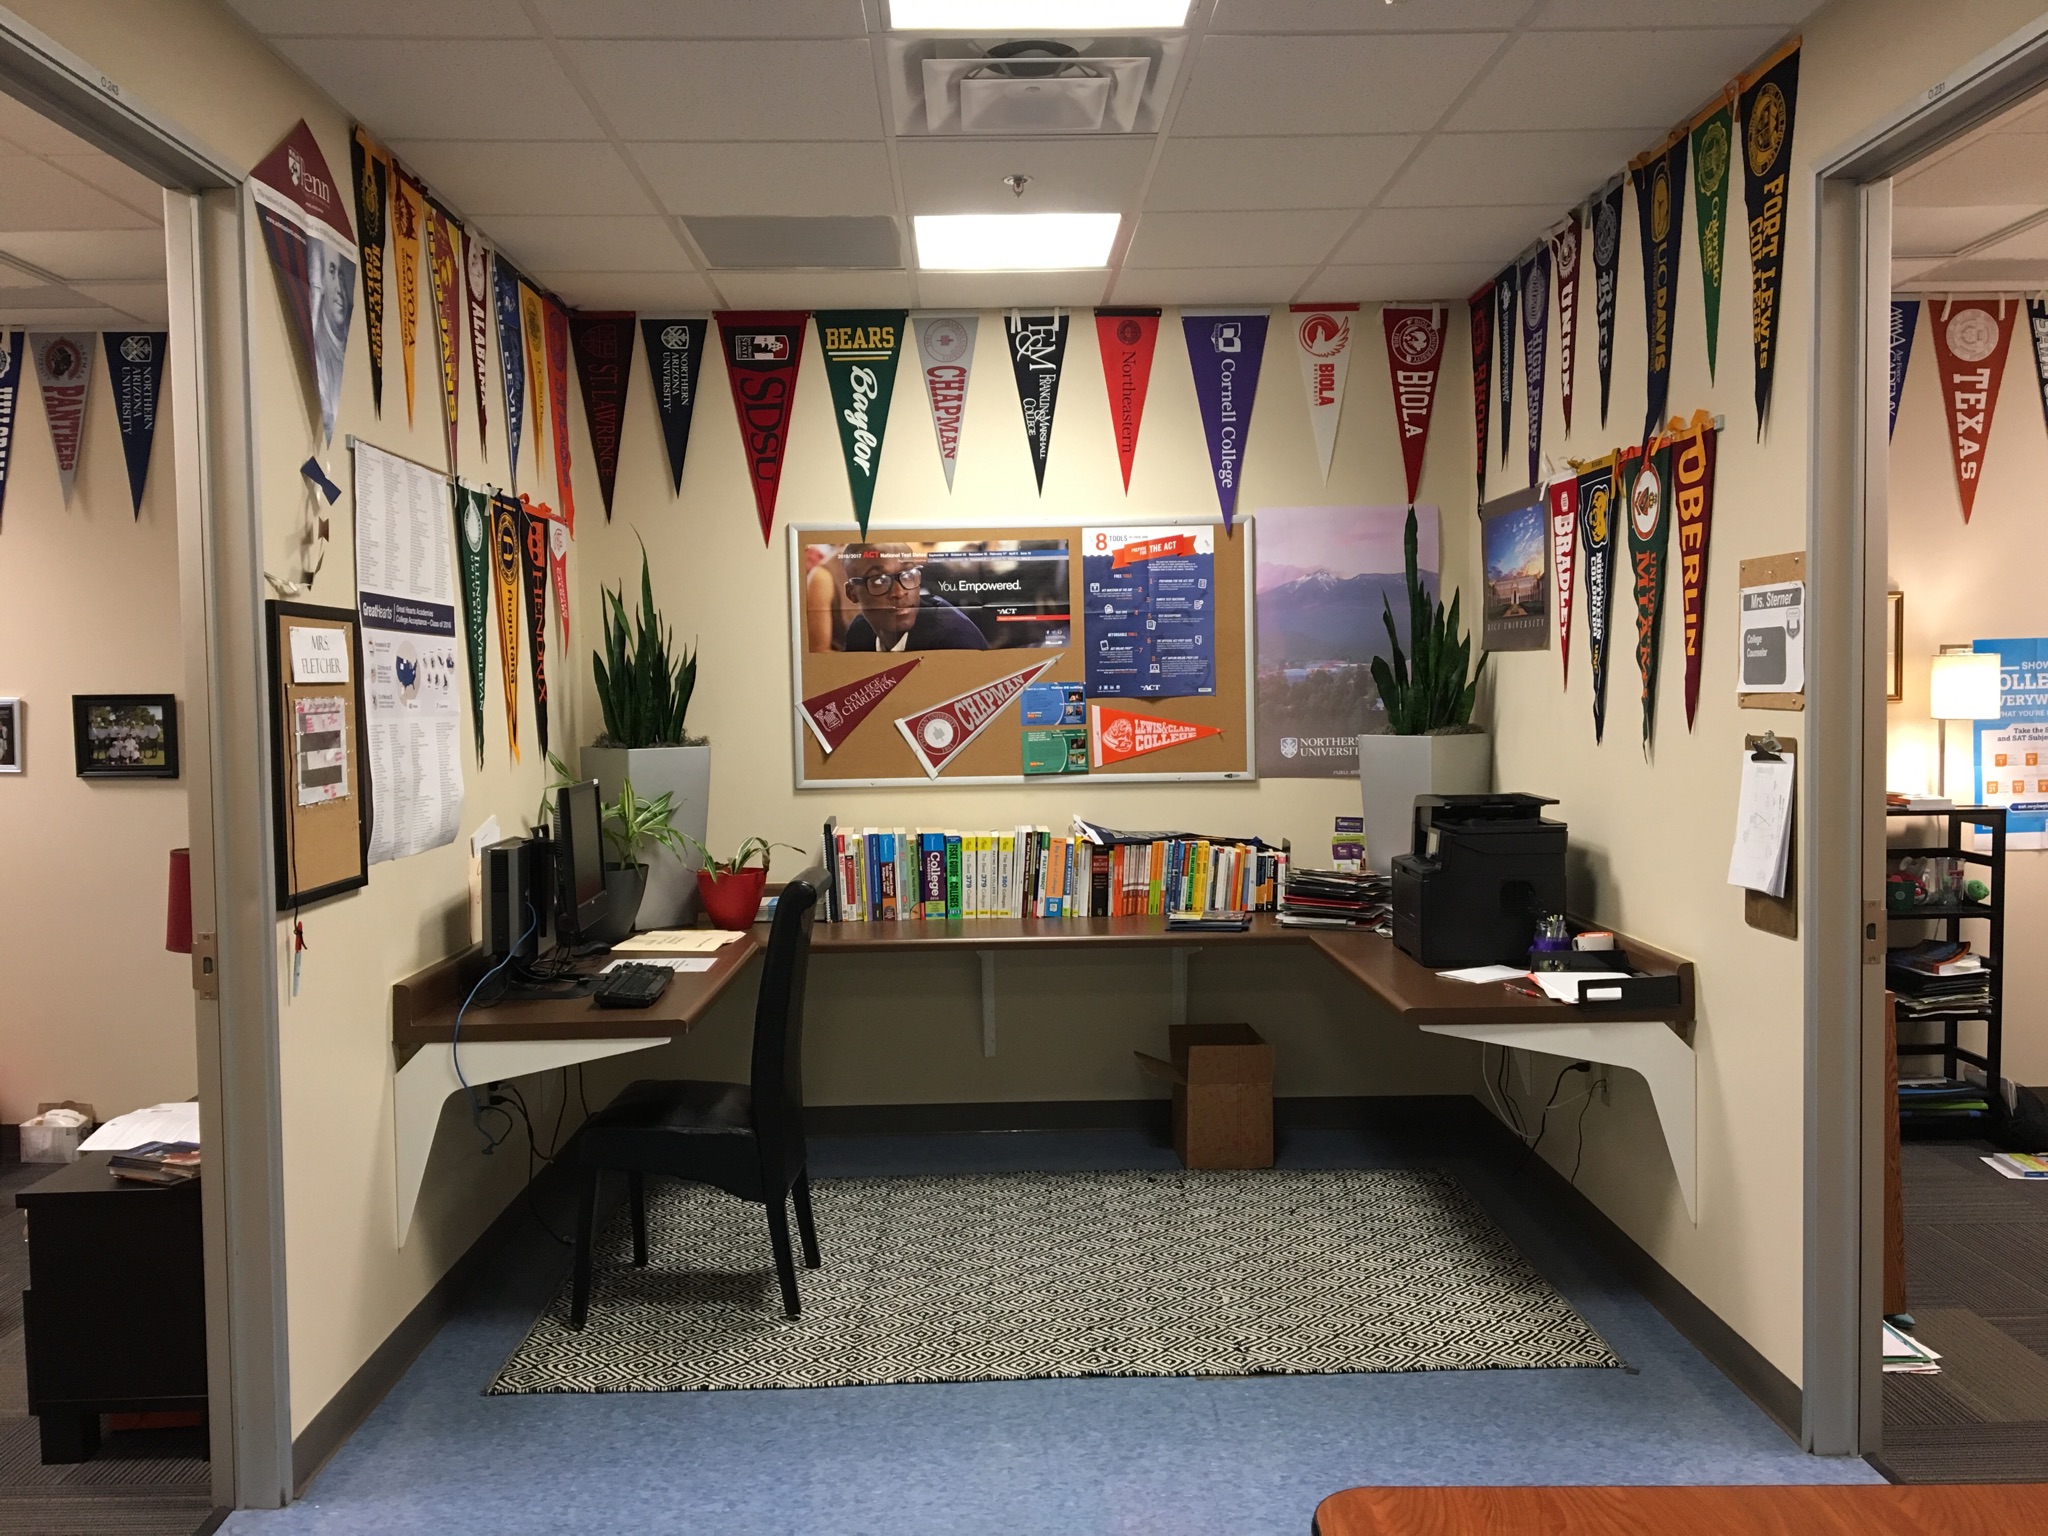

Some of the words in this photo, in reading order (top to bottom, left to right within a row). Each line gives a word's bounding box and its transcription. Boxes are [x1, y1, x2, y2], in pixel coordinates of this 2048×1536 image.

[1711, 196, 1721, 288] Colorado
[1763, 173, 1784, 258] FORT
[1704, 221, 1713, 270] State
[365, 246, 377, 358] COLLEGE
[372, 243, 382, 316] HARVEY
[405, 252, 415, 348] LOYOLA
[1749, 215, 1764, 344] COLLEGE
[374, 320, 382, 368] MUDD
[825, 327, 895, 350] BEARS
[1561, 281, 1574, 397] UNION
[1760, 267, 1776, 370] LEWIS
[472, 301, 487, 408] ALABAMA
[662, 352, 672, 411] UNIVERSITY
[671, 352, 680, 396] ARIZONA
[681, 352, 690, 406] NORTHERN
[1532, 329, 1543, 381] HIGH
[122, 366, 132, 435] UNIVERSITY
[133, 366, 142, 418] ARIZONA
[143, 367, 153, 430] NORTHERN
[504, 351, 518, 447] DEVILS
[926, 365, 968, 460] CHAPMAN
[1121, 351, 1136, 453] Northeastern
[1221, 359, 1236, 423] Cornell
[1319, 364, 1335, 407] BIOLA
[1397, 371, 1434, 438] BIOLA
[43, 385, 85, 472] PANTHERS
[591, 390, 617, 478] LAWRENCE
[739, 377, 787, 482] SDSU
[844, 365, 878, 477] Baylor
[1023, 398, 1037, 436] COLLEGE
[1530, 385, 1540, 451] POINT
[1953, 368, 1990, 479] TEXAS
[1218, 427, 1236, 488] College
[863, 551, 879, 559] ACT
[1095, 533, 1107, 551] 8
[1149, 544, 1161, 553] THE
[1164, 541, 1177, 551] ACT
[470, 555, 479, 640] UNIVERSITY
[474, 555, 483, 624] ILLINOIS
[937, 580, 958, 592] You.
[959, 580, 1021, 593] Empowered.
[1554, 512, 1575, 639] BRADLEY
[1590, 556, 1598, 637] COLORADO
[1595, 552, 1603, 640] NORTHERN
[1751, 594, 1764, 608] Mrs.
[1766, 592, 1793, 607] Sterner
[363, 602, 392, 620] GreatHearts
[508, 589, 516, 685] Augustana
[532, 568, 547, 704] HENDRIX
[1747, 635, 1762, 645] College
[301, 658, 342, 674] FLETCHER
[311, 635, 329, 651] MRS.
[1747, 648, 1768, 657] Counselor
[841, 677, 897, 717] CHARLESTON
[844, 677, 882, 704] COLLEGE
[880, 673, 888, 685] of
[954, 675, 1025, 730] CHAPMAN
[2000, 673, 2048, 691] OLLE
[2000, 694, 2048, 706] VERYW
[1135, 732, 1196, 751] COLLEGE
[1300, 747, 1359, 757] UNIVERSIT
[929, 852, 940, 896] College
[949, 844, 958, 860] FISKE
[949, 861, 958, 877] GUIDE
[949, 881, 958, 908] COLLEGES
